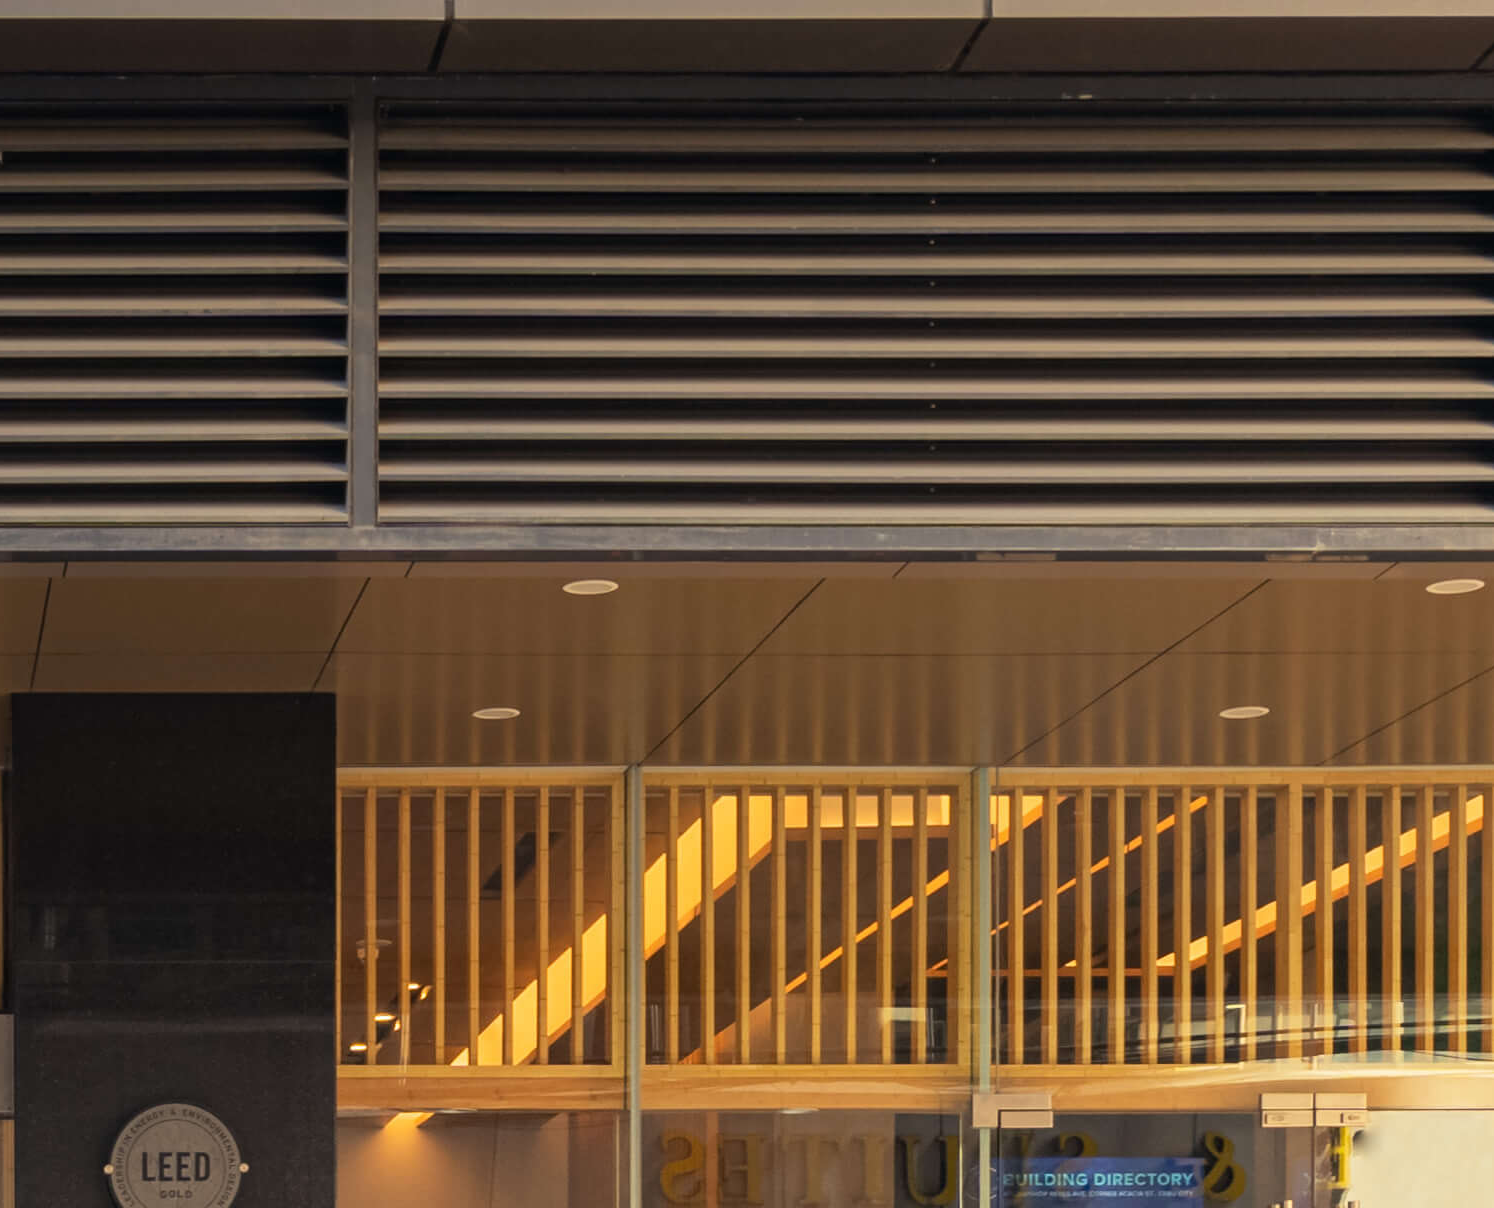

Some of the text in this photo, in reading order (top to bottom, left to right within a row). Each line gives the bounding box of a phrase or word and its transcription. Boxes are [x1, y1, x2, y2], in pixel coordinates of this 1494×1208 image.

[141, 1151, 211, 1182] LEED
[1002, 1172, 1194, 1187] BUILDING DIRECTORY
[159, 1190, 193, 1199] GOLD
